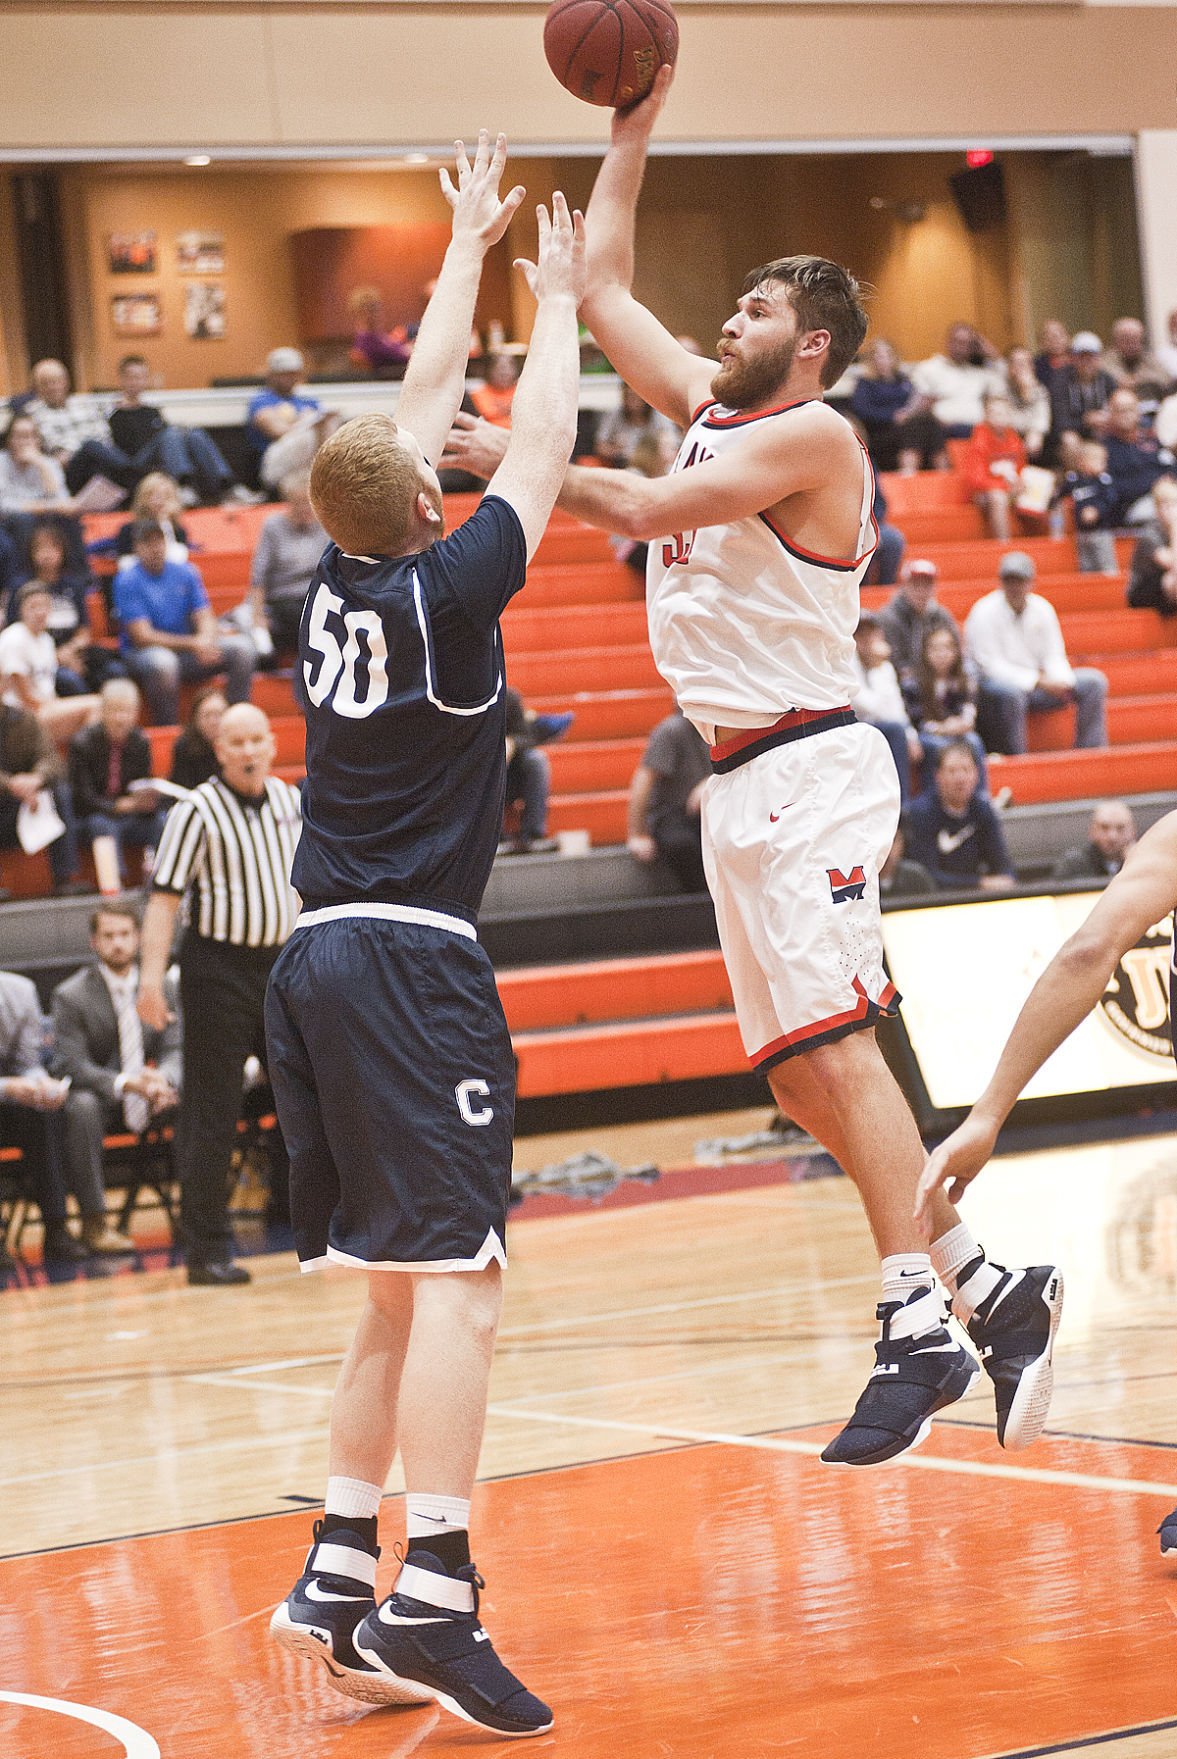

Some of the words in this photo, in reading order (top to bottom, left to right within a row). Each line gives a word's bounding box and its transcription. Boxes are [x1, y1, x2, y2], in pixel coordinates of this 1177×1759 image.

[303, 582, 389, 719] 50
[826, 866, 866, 904] M
[455, 1079, 494, 1127] C
